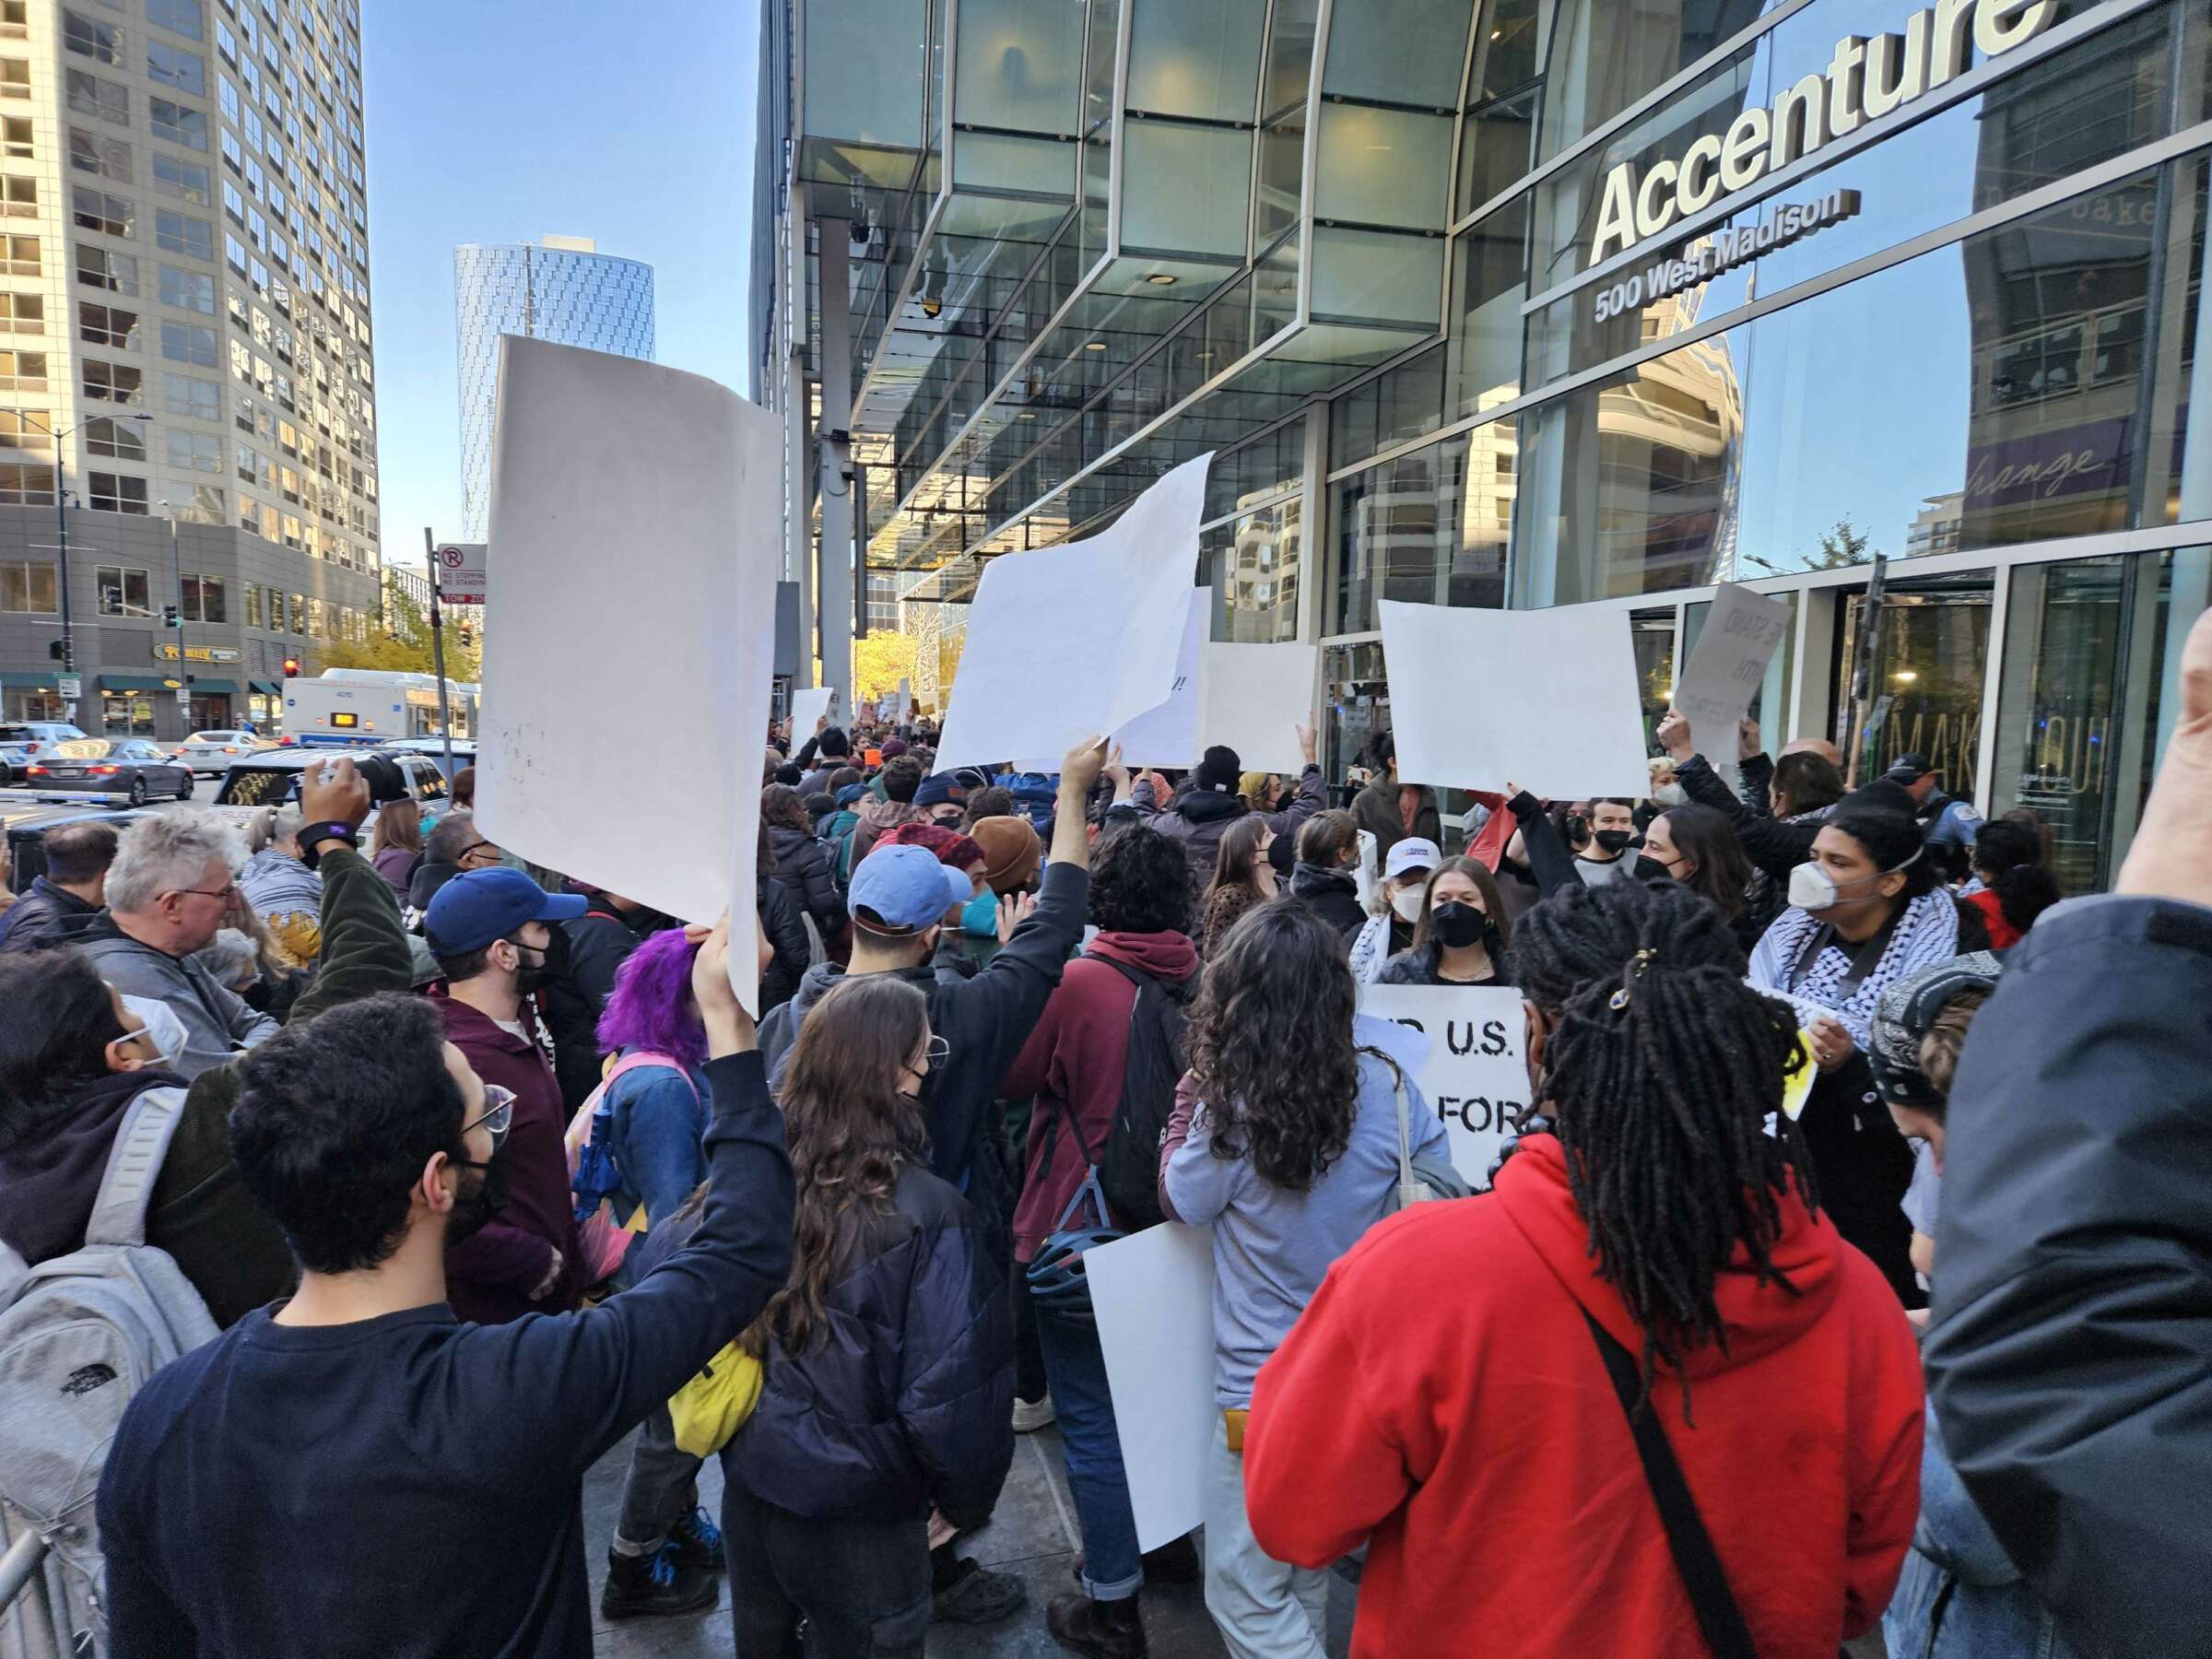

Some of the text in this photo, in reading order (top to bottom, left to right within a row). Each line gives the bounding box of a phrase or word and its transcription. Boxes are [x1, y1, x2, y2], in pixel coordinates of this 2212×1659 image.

[1588, 0, 2052, 267] Accenture
[1594, 188, 1843, 324] 500 West Madison
[445, 594, 465, 603] TOW
[1447, 1019, 1513, 1056] U.S.
[1438, 1096, 1524, 1135] FOR
